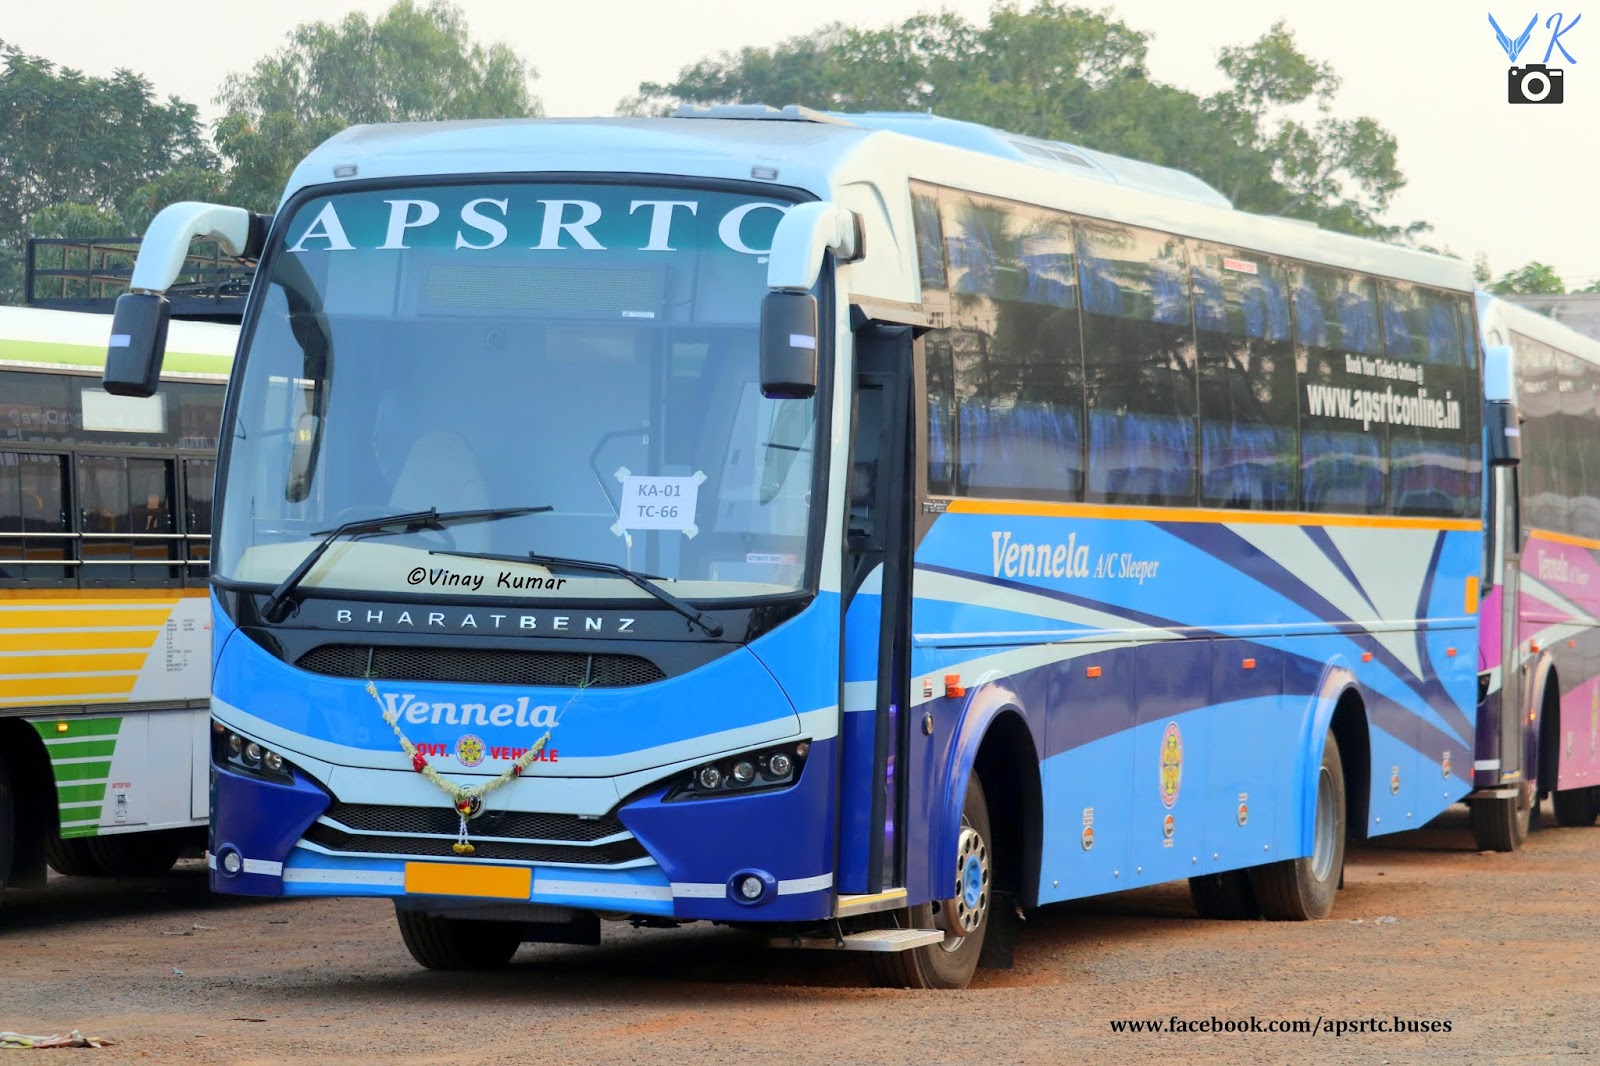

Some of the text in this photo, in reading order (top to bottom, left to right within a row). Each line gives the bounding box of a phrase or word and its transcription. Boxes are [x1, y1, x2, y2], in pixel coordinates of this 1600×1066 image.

[286, 197, 796, 256] APSRTC
[1375, 358, 1397, 380] Tickets
[1398, 360, 1417, 383] Online
[1306, 384, 1461, 432] www.apsrtconline.in
[638, 484, 681, 497] KA-01
[637, 505, 678, 518] TC-66
[991, 531, 1160, 585] Vennela A/C Sleeper
[336, 609, 636, 633] BHARATBENZ
[383, 693, 560, 728] Vennela
[410, 742, 450, 757] OVT.
